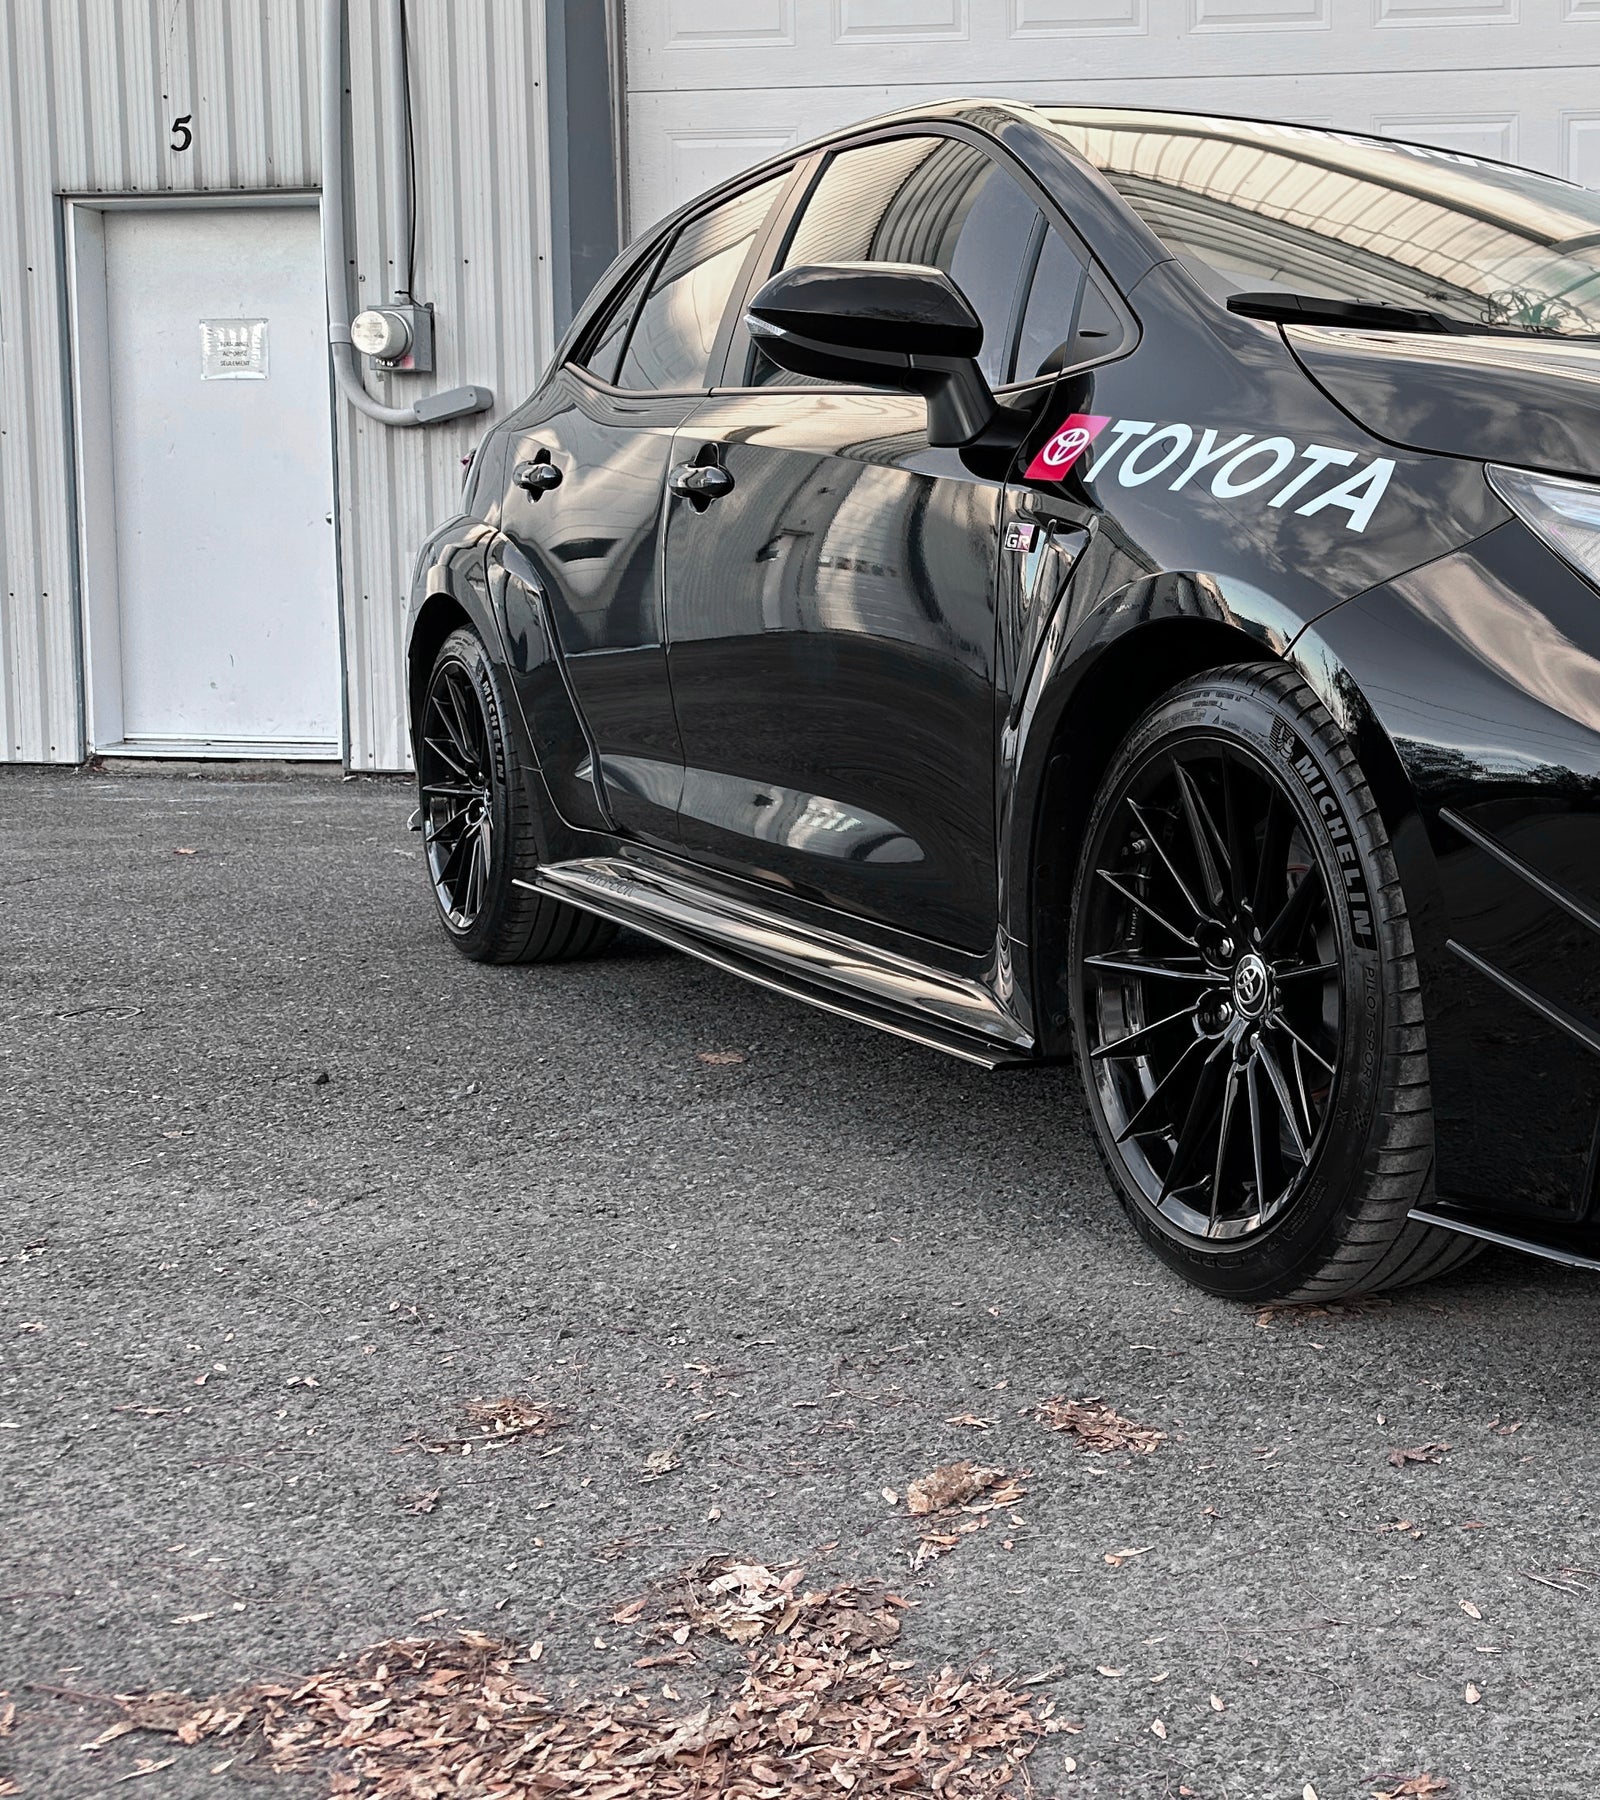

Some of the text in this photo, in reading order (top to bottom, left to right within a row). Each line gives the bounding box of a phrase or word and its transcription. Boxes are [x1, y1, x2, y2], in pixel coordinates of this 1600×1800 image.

[170, 114, 192, 151] 5
[1083, 420, 1396, 533] TOYOTA
[1006, 533, 1031, 550] GR
[482, 680, 505, 778] MICHELIN
[1294, 754, 1372, 936] MICHELIN
[1359, 966, 1377, 1090] PILOT SPORT
